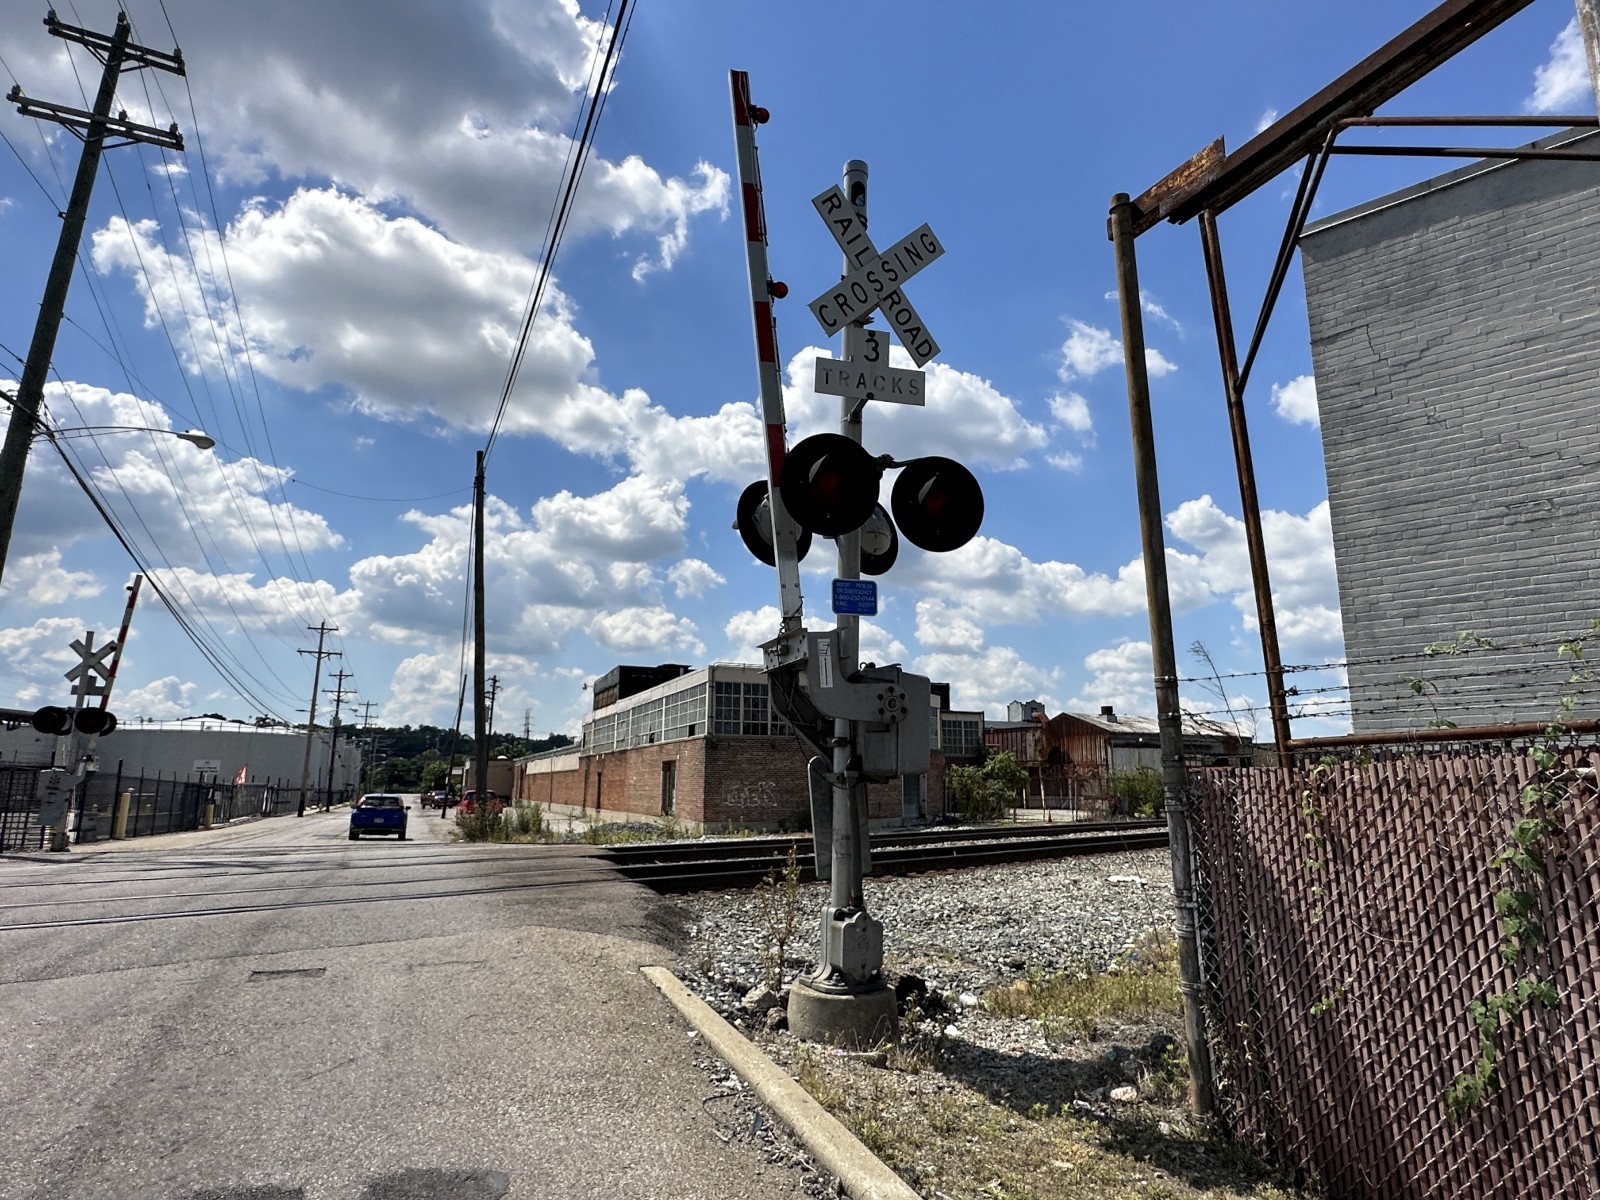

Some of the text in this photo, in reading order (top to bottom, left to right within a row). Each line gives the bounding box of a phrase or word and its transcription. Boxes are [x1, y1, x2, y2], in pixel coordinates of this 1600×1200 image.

[818, 232, 937, 328] CROSSING
[821, 192, 932, 358] RAIL ROAD
[822, 367, 920, 396] TRACKS
[863, 338, 880, 363] 3
